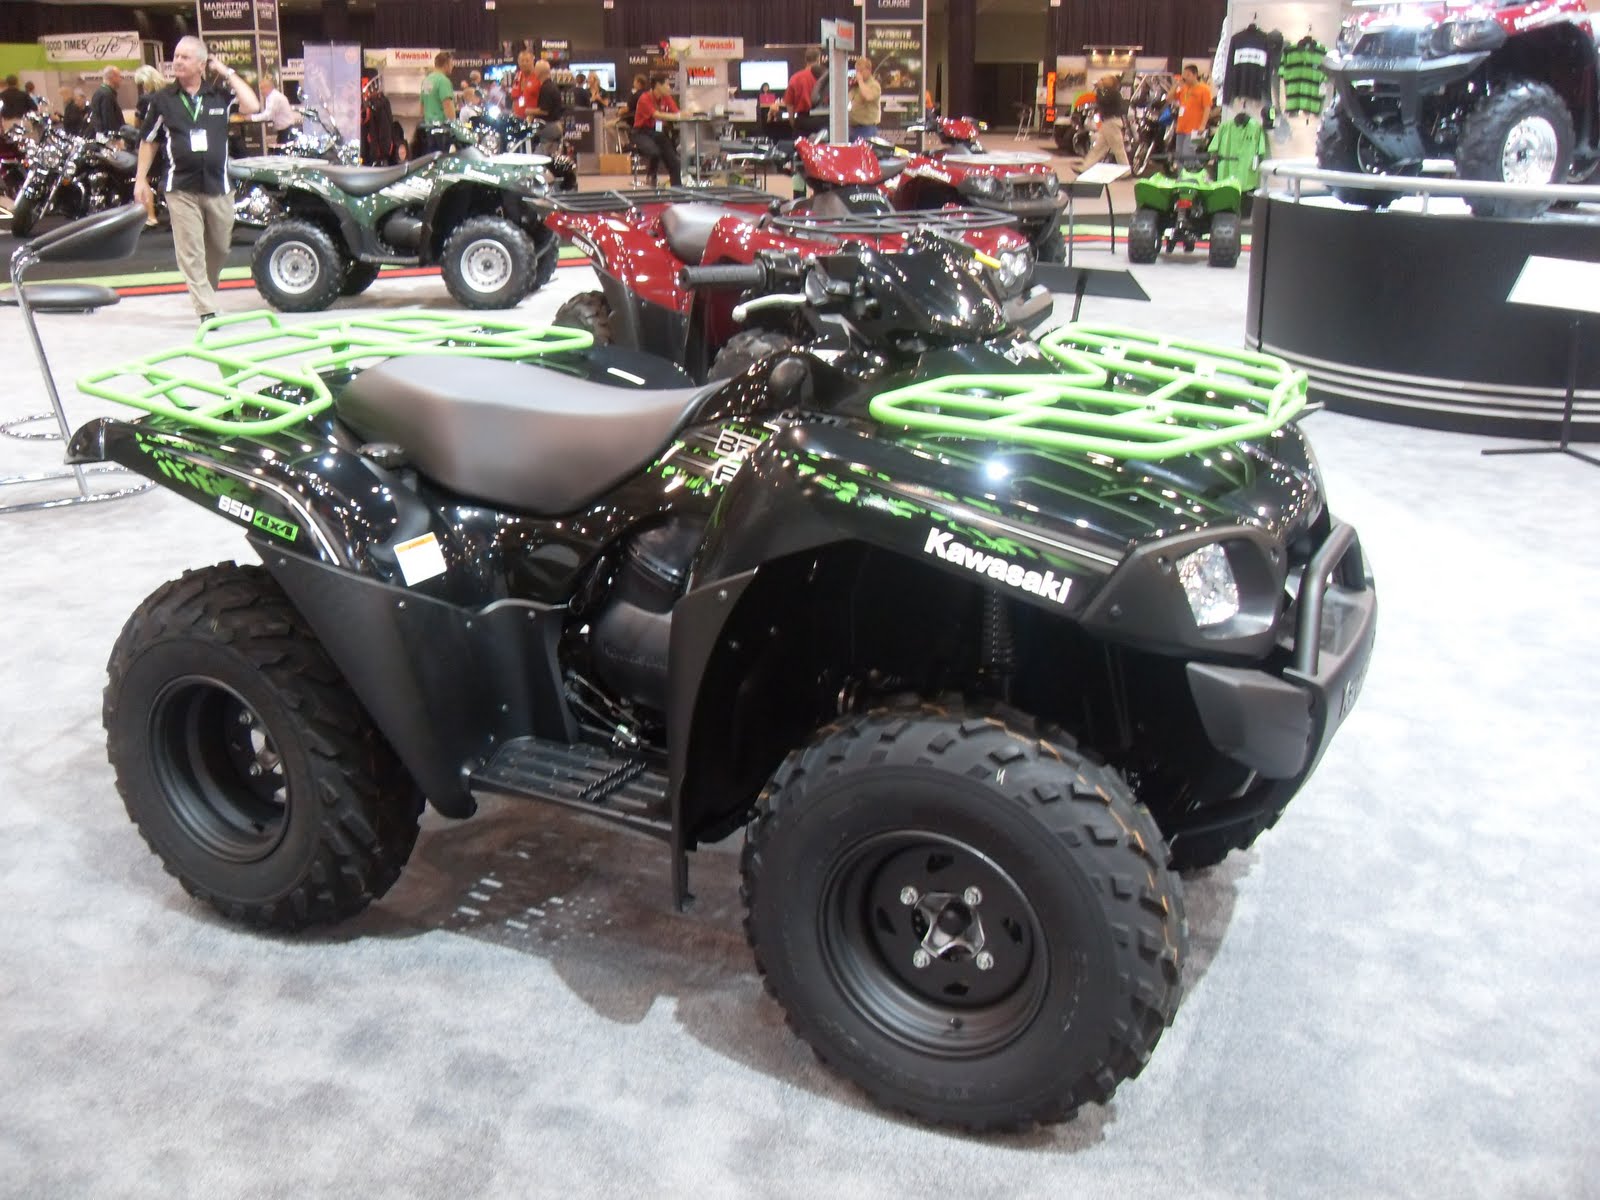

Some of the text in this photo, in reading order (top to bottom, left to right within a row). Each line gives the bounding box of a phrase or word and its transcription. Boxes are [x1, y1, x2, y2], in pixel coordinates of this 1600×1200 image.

[204, 2, 250, 11] MARKETING
[212, 10, 243, 19] LOUNGE
[875, 29, 912, 39] WEBSITE
[64, 39, 86, 51] TIMES
[209, 40, 251, 52] ONLINE
[541, 40, 568, 49] Kawasaki
[699, 39, 736, 50] Kawasaki
[867, 40, 921, 50] MARKETING
[395, 51, 432, 60] Kawasaki
[218, 494, 254, 522] 650
[923, 527, 1073, 604] Kawasaki
